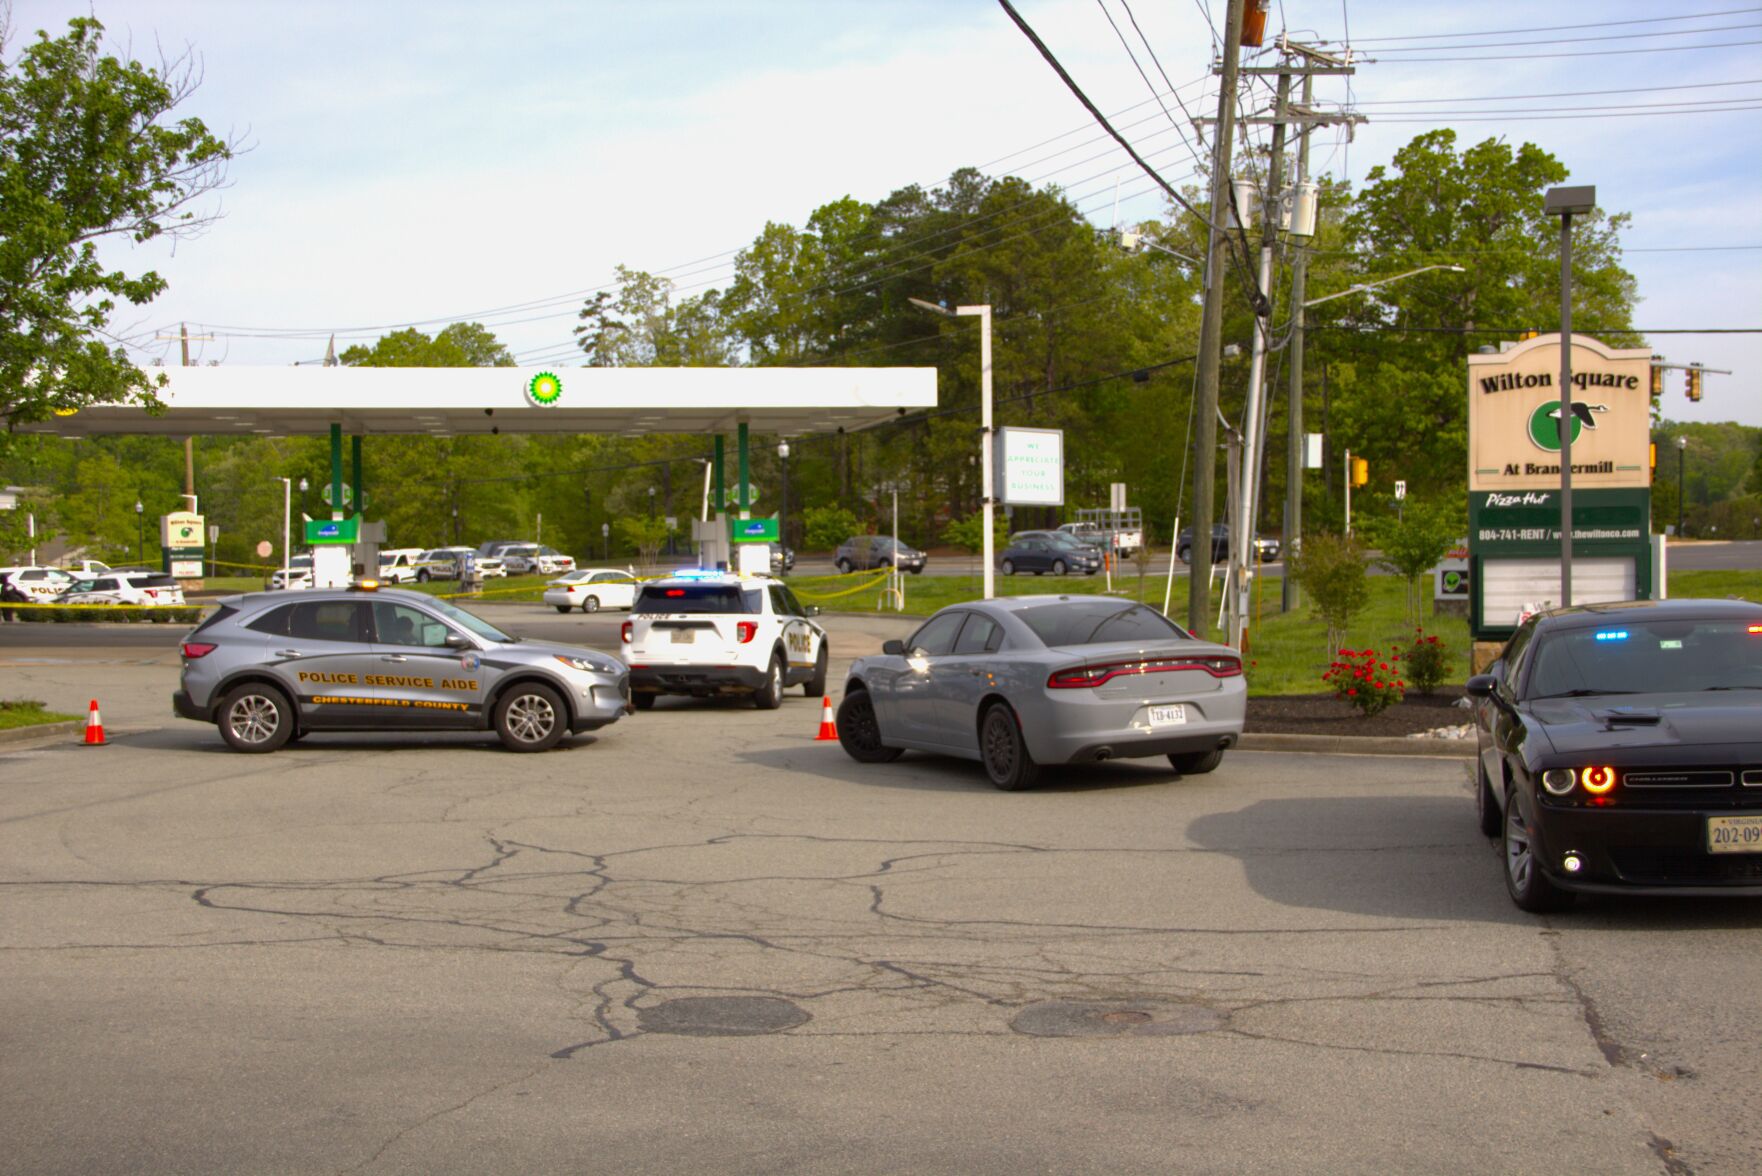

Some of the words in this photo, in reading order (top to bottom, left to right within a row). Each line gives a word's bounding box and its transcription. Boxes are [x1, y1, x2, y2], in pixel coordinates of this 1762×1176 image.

[1480, 372, 1552, 394] Wilton
[1504, 463, 1519, 476] At
[1525, 461, 1613, 476] Branermill
[1011, 482, 1055, 490] BUSINESS
[1485, 493, 1521, 507] Pizza
[1523, 492, 1550, 505] Hut
[1479, 529, 1545, 540] 804-741-RENT
[1553, 529, 1639, 539] w.thewiltonco.com
[31, 587, 64, 595] POLIC
[299, 672, 357, 684] POLICE
[365, 675, 433, 687] SERVICE
[441, 679, 478, 690] AIDE
[313, 696, 410, 707] CHESTERFIELD
[414, 701, 469, 711] COUNTY
[1714, 827, 1762, 843] 202-09
